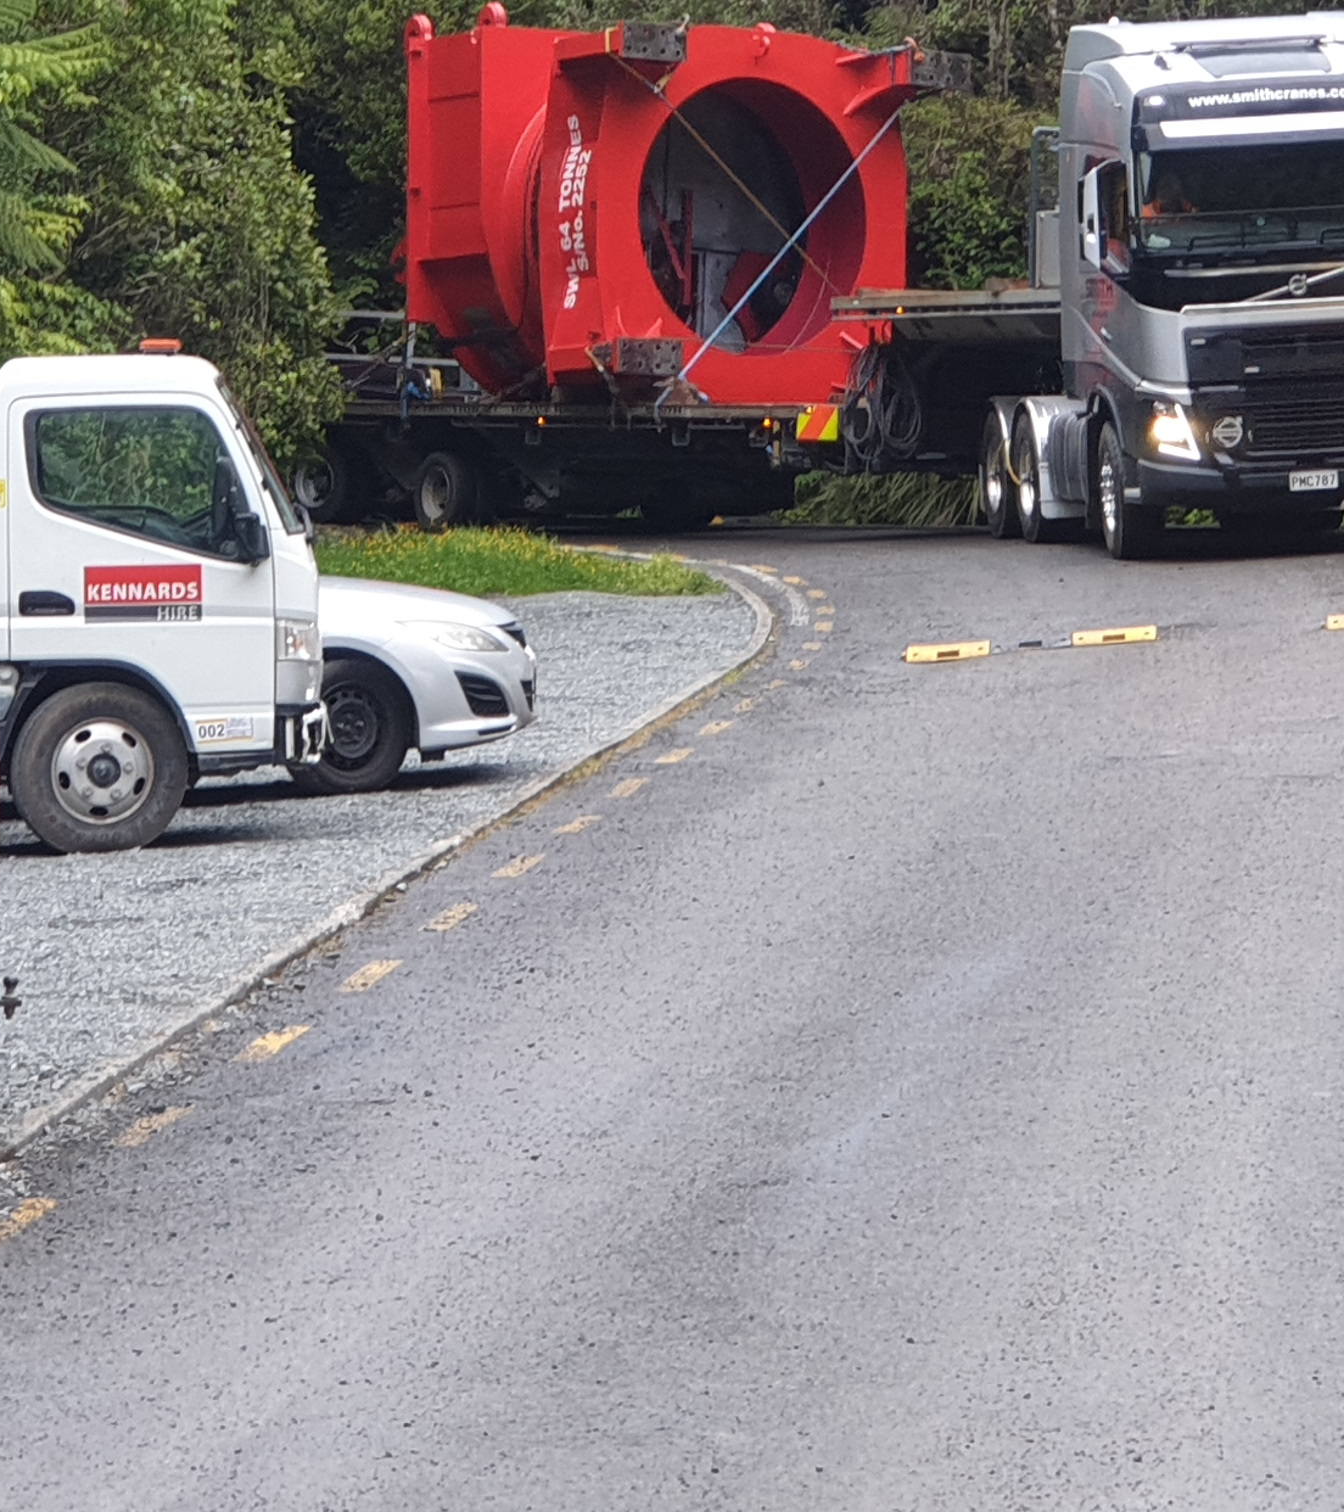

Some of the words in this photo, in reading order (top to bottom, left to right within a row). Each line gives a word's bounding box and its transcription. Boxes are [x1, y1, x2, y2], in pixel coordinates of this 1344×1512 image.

[558, 114, 583, 213] TONNES
[571, 149, 592, 207] 2252
[558, 220, 573, 251] 64
[572, 209, 590, 271] S/No.
[563, 258, 580, 310] SWL
[1291, 474, 1336, 488] PMC787
[87, 581, 198, 601] KENNARDS
[156, 605, 198, 622] HIRE
[198, 724, 225, 739] 002
